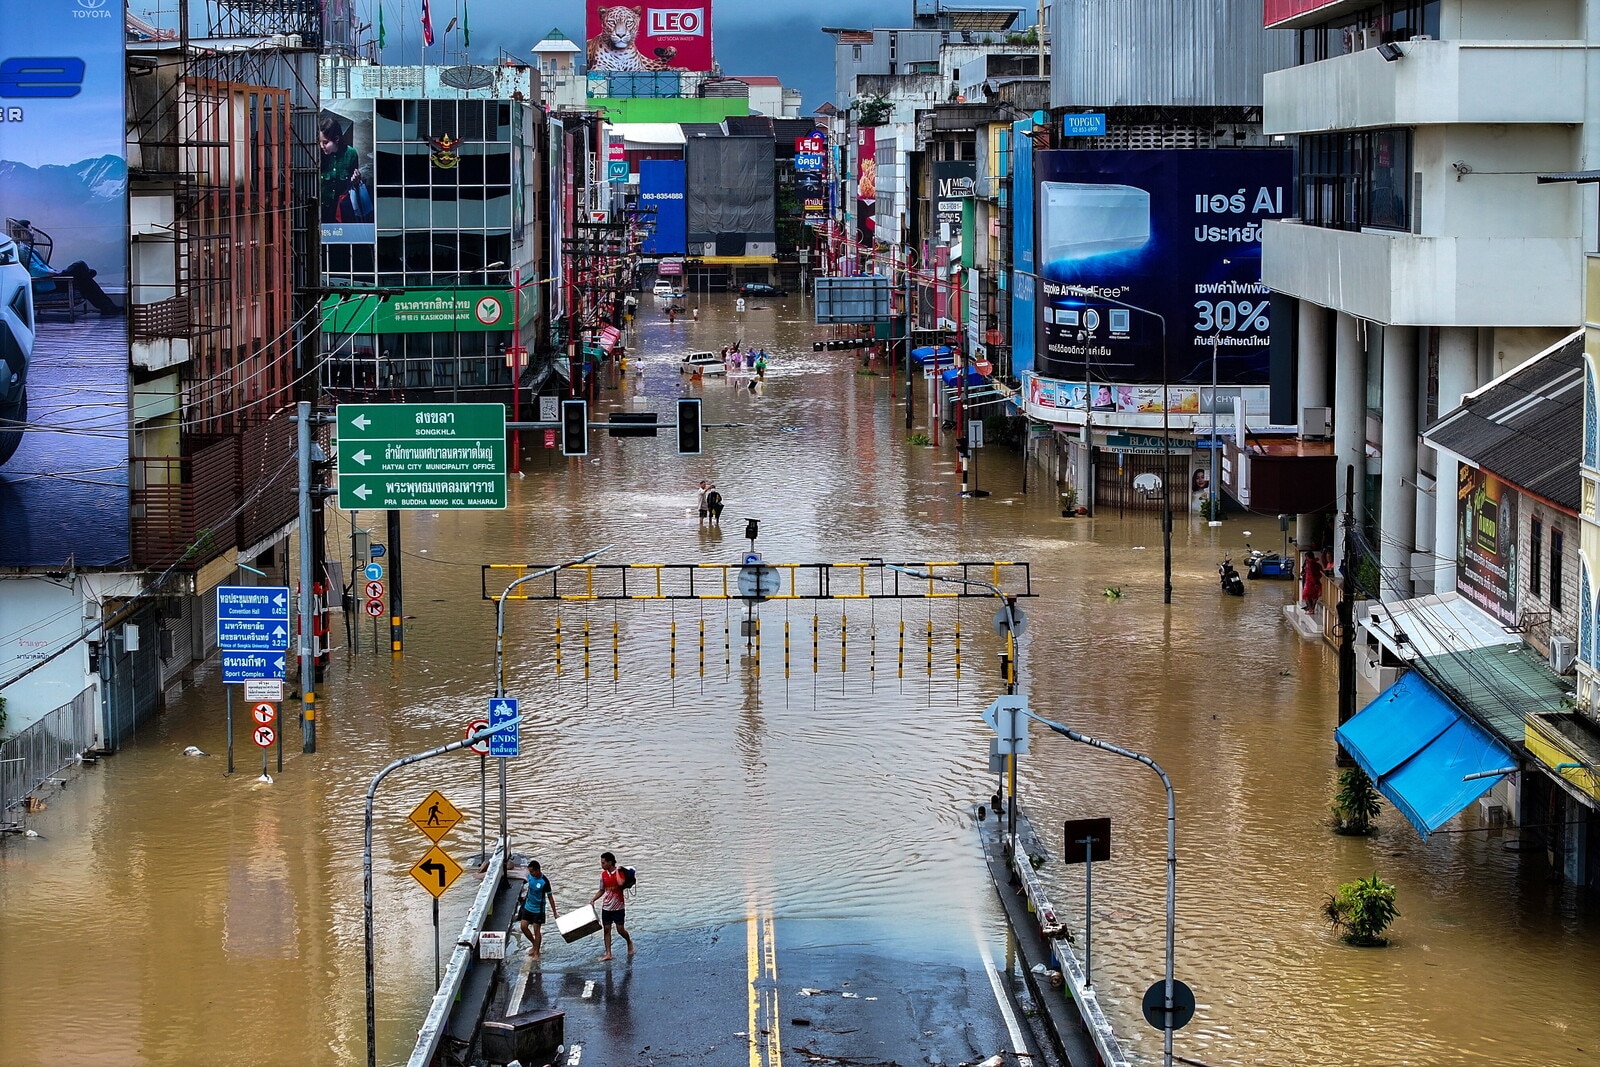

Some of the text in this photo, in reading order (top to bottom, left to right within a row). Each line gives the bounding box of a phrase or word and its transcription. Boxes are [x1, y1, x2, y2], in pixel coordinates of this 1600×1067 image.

[72, 10, 112, 18] TOYOTA
[652, 12, 700, 33] LEO
[1069, 116, 1101, 127] TOPGUN
[797, 155, 821, 168] อัดรูป
[1195, 186, 1283, 214] แอร์ AI
[1194, 300, 1270, 331] 30%
[1202, 394, 1235, 407] VCHY
[415, 412, 455, 424] สงขลา
[385, 441, 493, 462] สำนักงานเทศบาลนครหาดใหญ่
[386, 481, 495, 497] พระพุทธมงคลมหาราช
[224, 622, 265, 630] มหาวิทยาลัย
[223, 654, 267, 667] สนามกีฬา
[225, 670, 241, 678] Sport
[241, 670, 265, 678] Complex
[492, 735, 516, 743] ENDS
